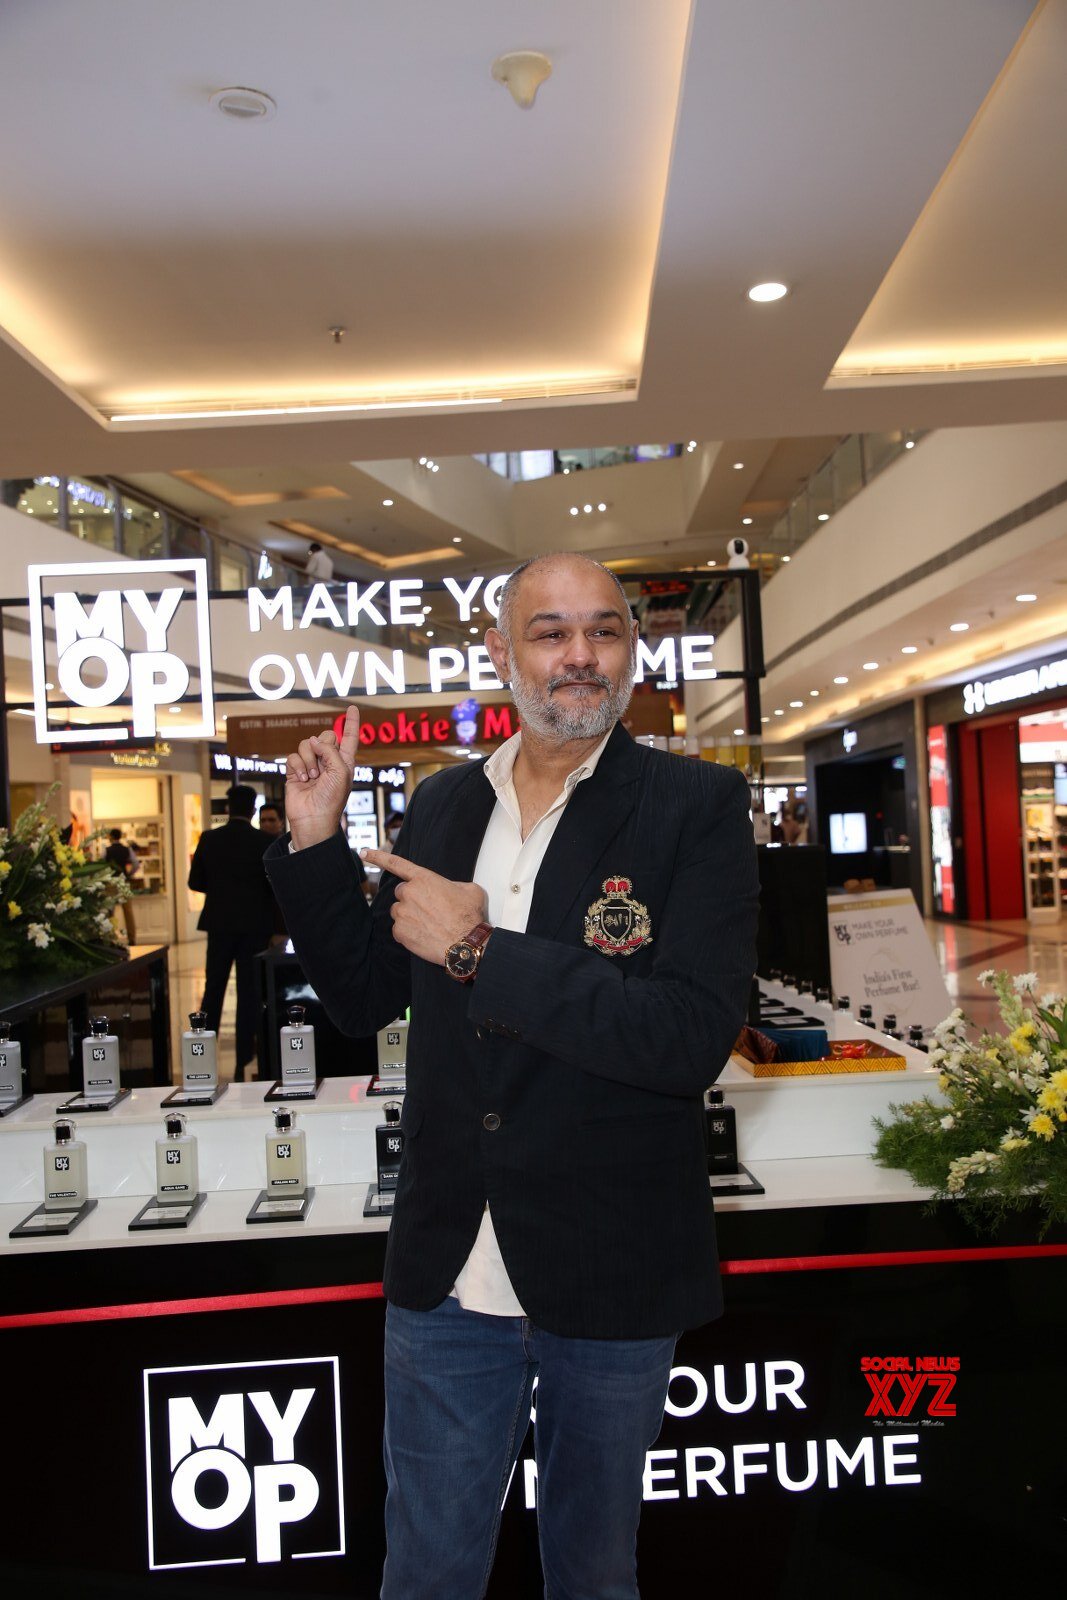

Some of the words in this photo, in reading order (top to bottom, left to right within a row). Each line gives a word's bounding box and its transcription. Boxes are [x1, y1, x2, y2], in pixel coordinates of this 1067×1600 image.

[248, 579, 425, 632] MAKE
[249, 650, 405, 700] OWN
[852, 922, 872, 930] MAKE
[855, 931, 875, 940] OWN
[876, 926, 908, 938] PERFUME
[863, 972, 891, 985] India's
[892, 969, 913, 979] First
[864, 984, 900, 998] Perfume
[664, 1361, 807, 1418] OUR
[642, 1434, 922, 1501] ERFUME
